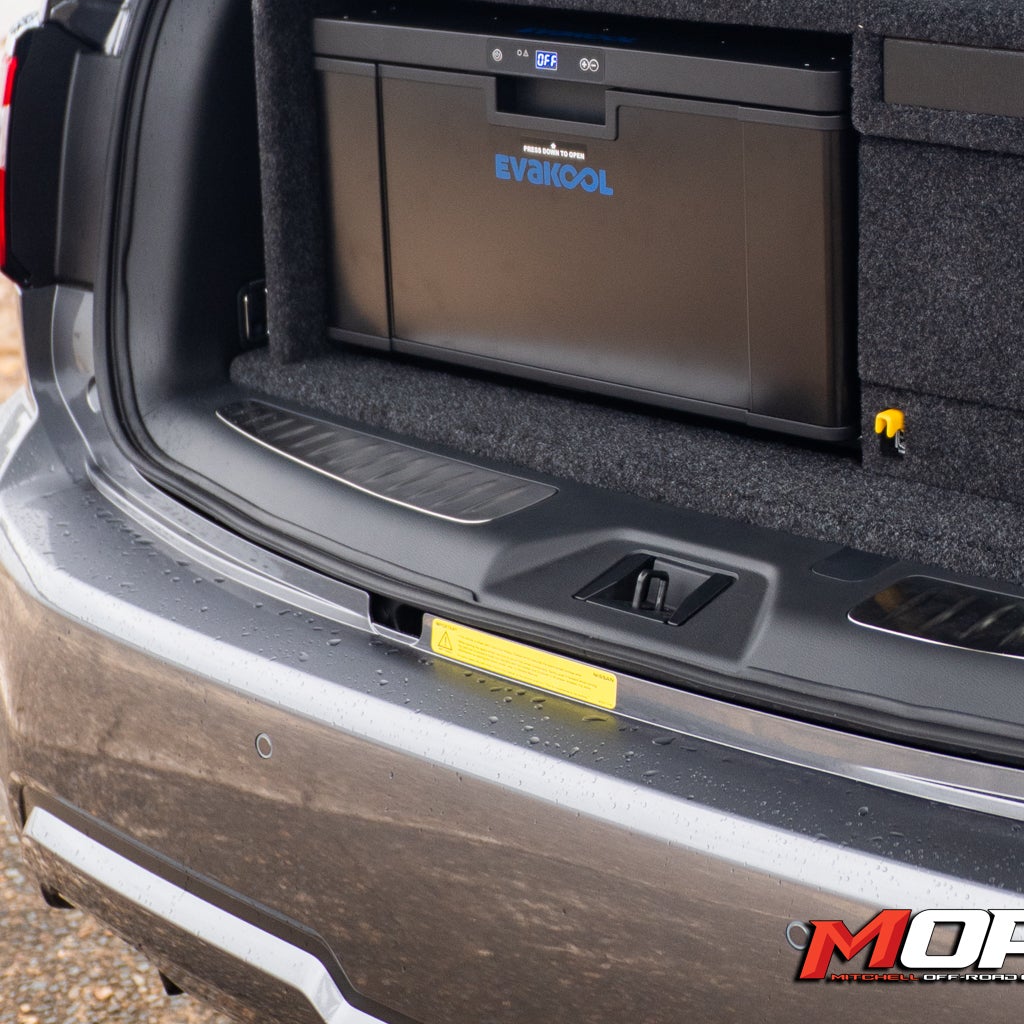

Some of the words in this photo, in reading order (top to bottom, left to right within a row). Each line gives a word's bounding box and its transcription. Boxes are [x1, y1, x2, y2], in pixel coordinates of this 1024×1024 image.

[536, 53, 557, 67] OFF
[523, 145, 541, 154] PRESS
[542, 147, 560, 156] DOWN
[569, 151, 585, 160] OPEN
